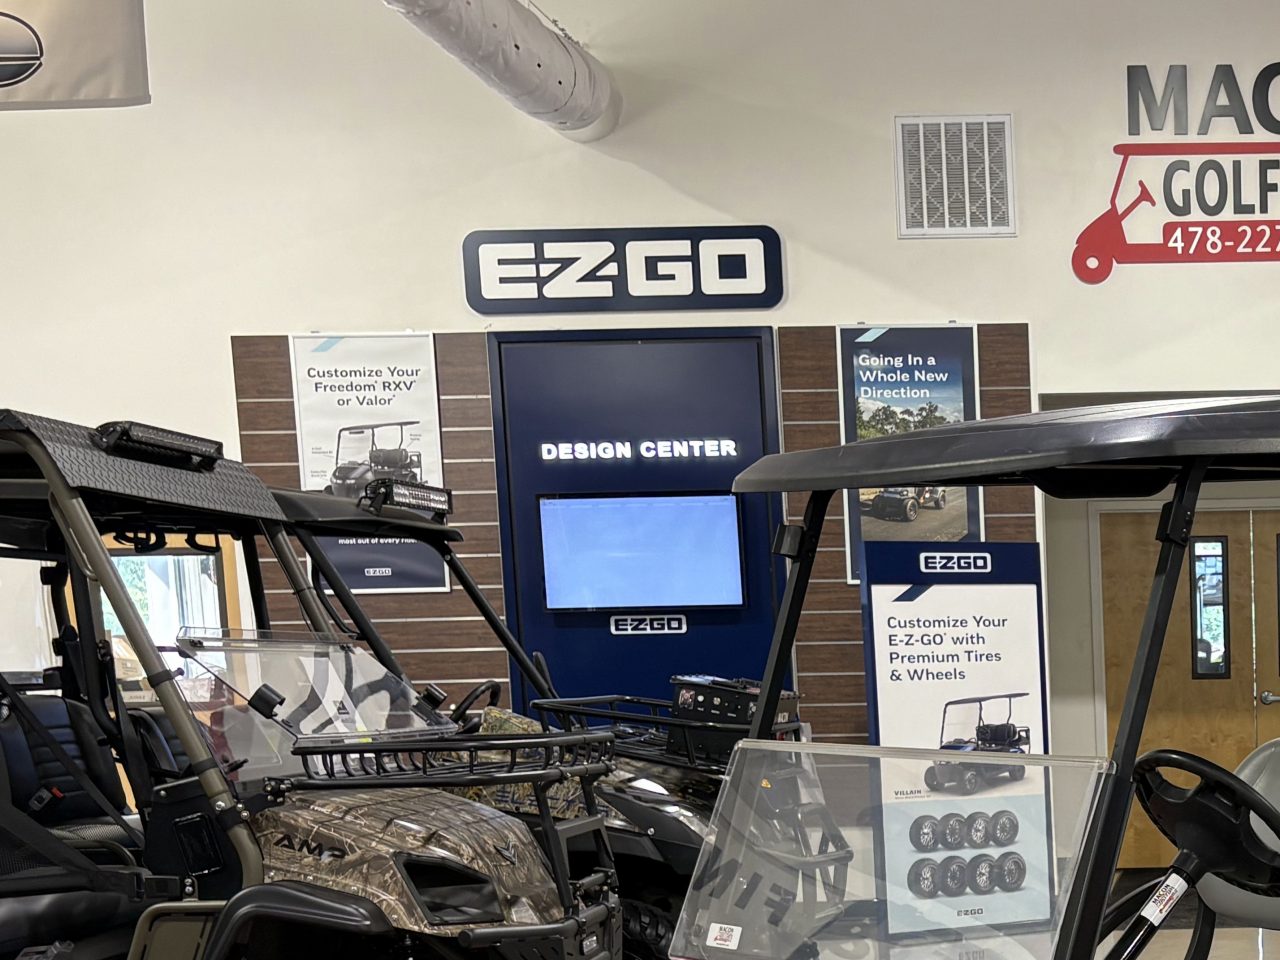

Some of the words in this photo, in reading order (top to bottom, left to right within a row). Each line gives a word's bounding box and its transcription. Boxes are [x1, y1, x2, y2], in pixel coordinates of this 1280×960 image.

[1163, 159, 1280, 216] GOLF
[858, 354, 904, 368] Going
[907, 354, 923, 366] In
[927, 356, 937, 366] a
[307, 367, 383, 379] Customize
[387, 366, 421, 377] Your
[859, 370, 910, 382] Whole
[914, 370, 949, 382] New
[860, 386, 930, 398] Direction
[337, 397, 352, 406] or
[541, 441, 632, 460] DESIGN
[639, 439, 738, 458] CENTER
[887, 616, 968, 629] Customize
[973, 616, 1008, 628] Your
[951, 633, 985, 645] with
[889, 651, 960, 665] Premium
[964, 650, 1002, 663] Tires
[889, 669, 903, 682] &
[907, 668, 966, 681] Wheels
